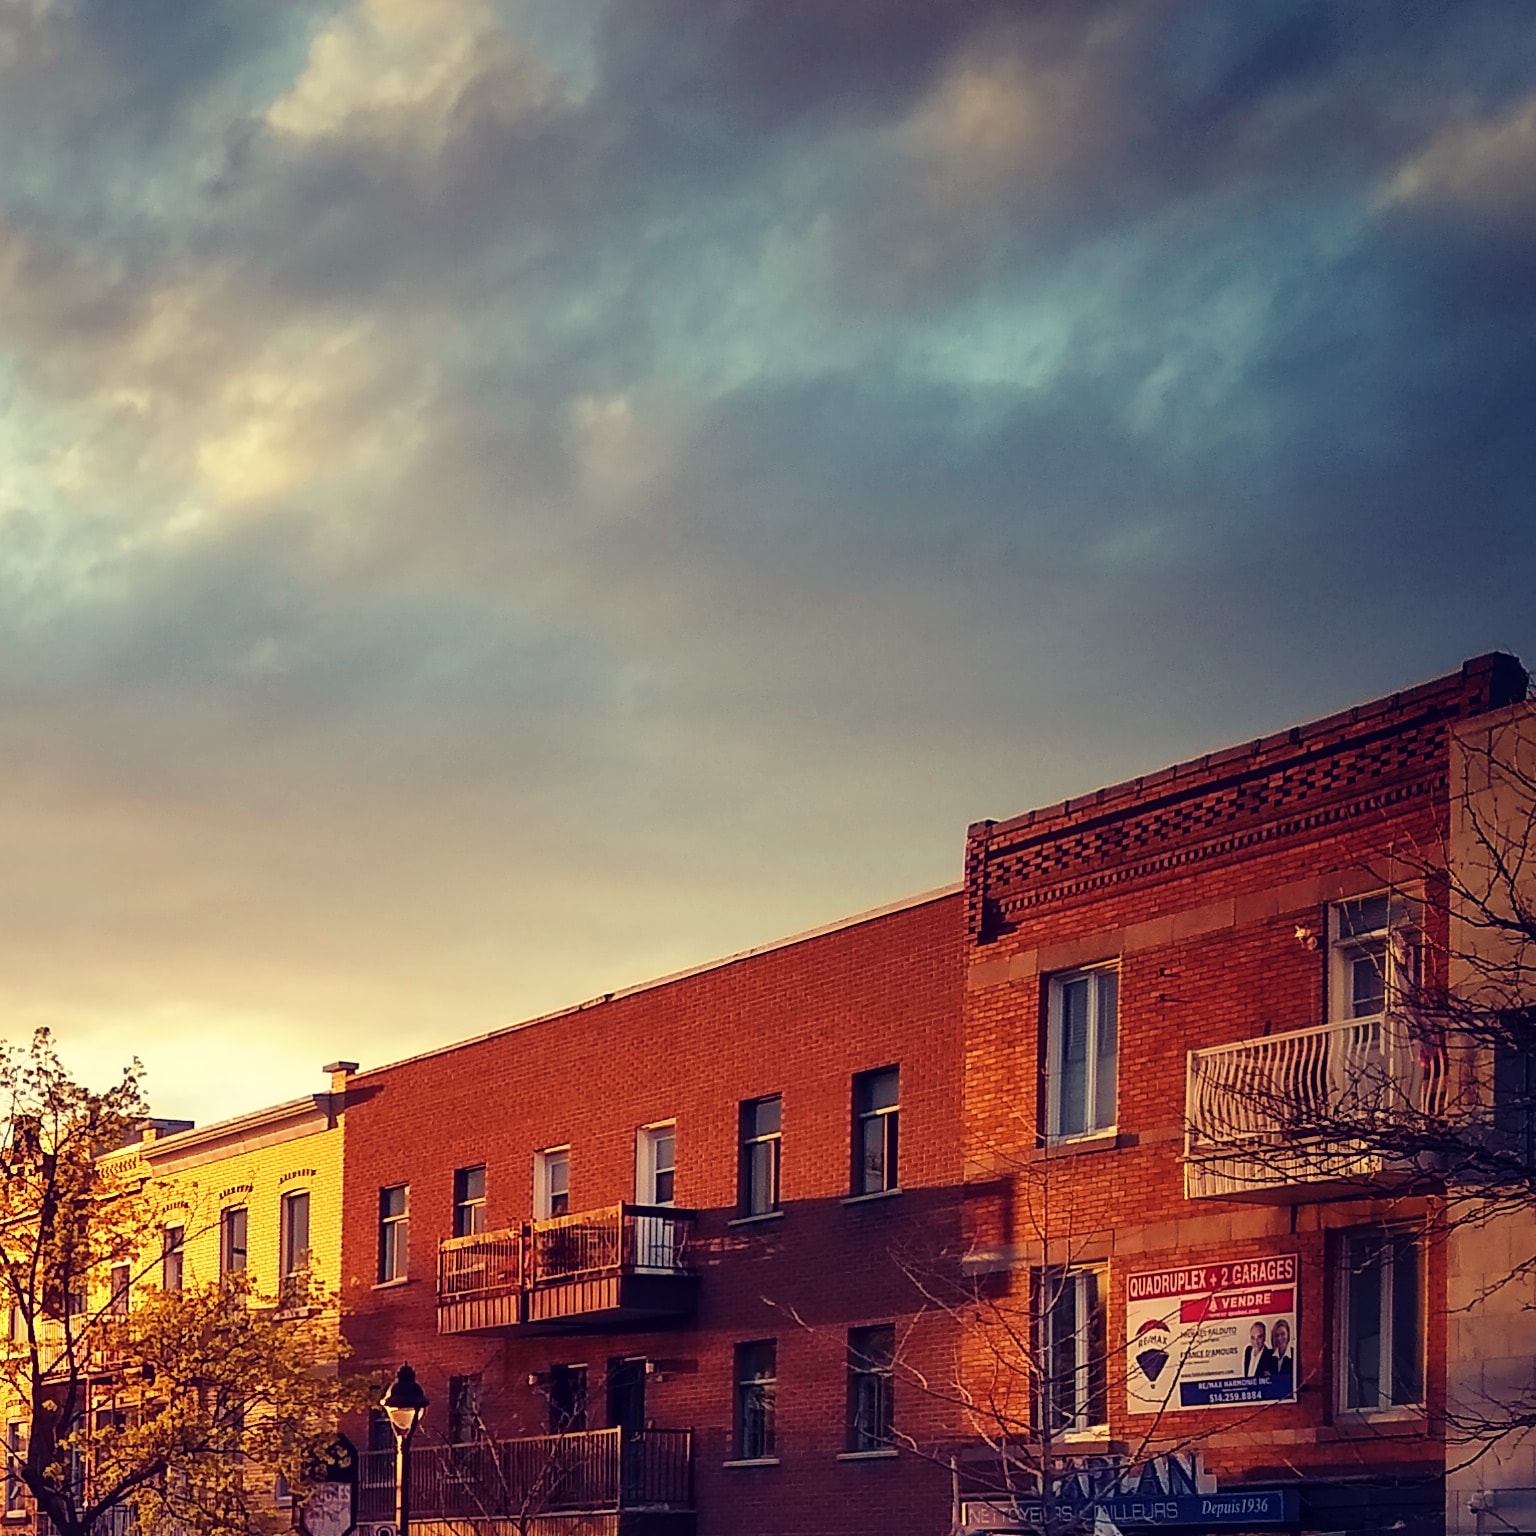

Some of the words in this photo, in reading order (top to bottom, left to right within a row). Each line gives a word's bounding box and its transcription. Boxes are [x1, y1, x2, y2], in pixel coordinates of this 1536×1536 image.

[1129, 1269, 1207, 1298] QUADRUPLEX
[1221, 1267, 1229, 1286] 2
[1232, 1259, 1294, 1285] GARAGES
[1221, 1293, 1272, 1309] VENDRE
[1198, 1382, 1222, 1391] RE/MAX
